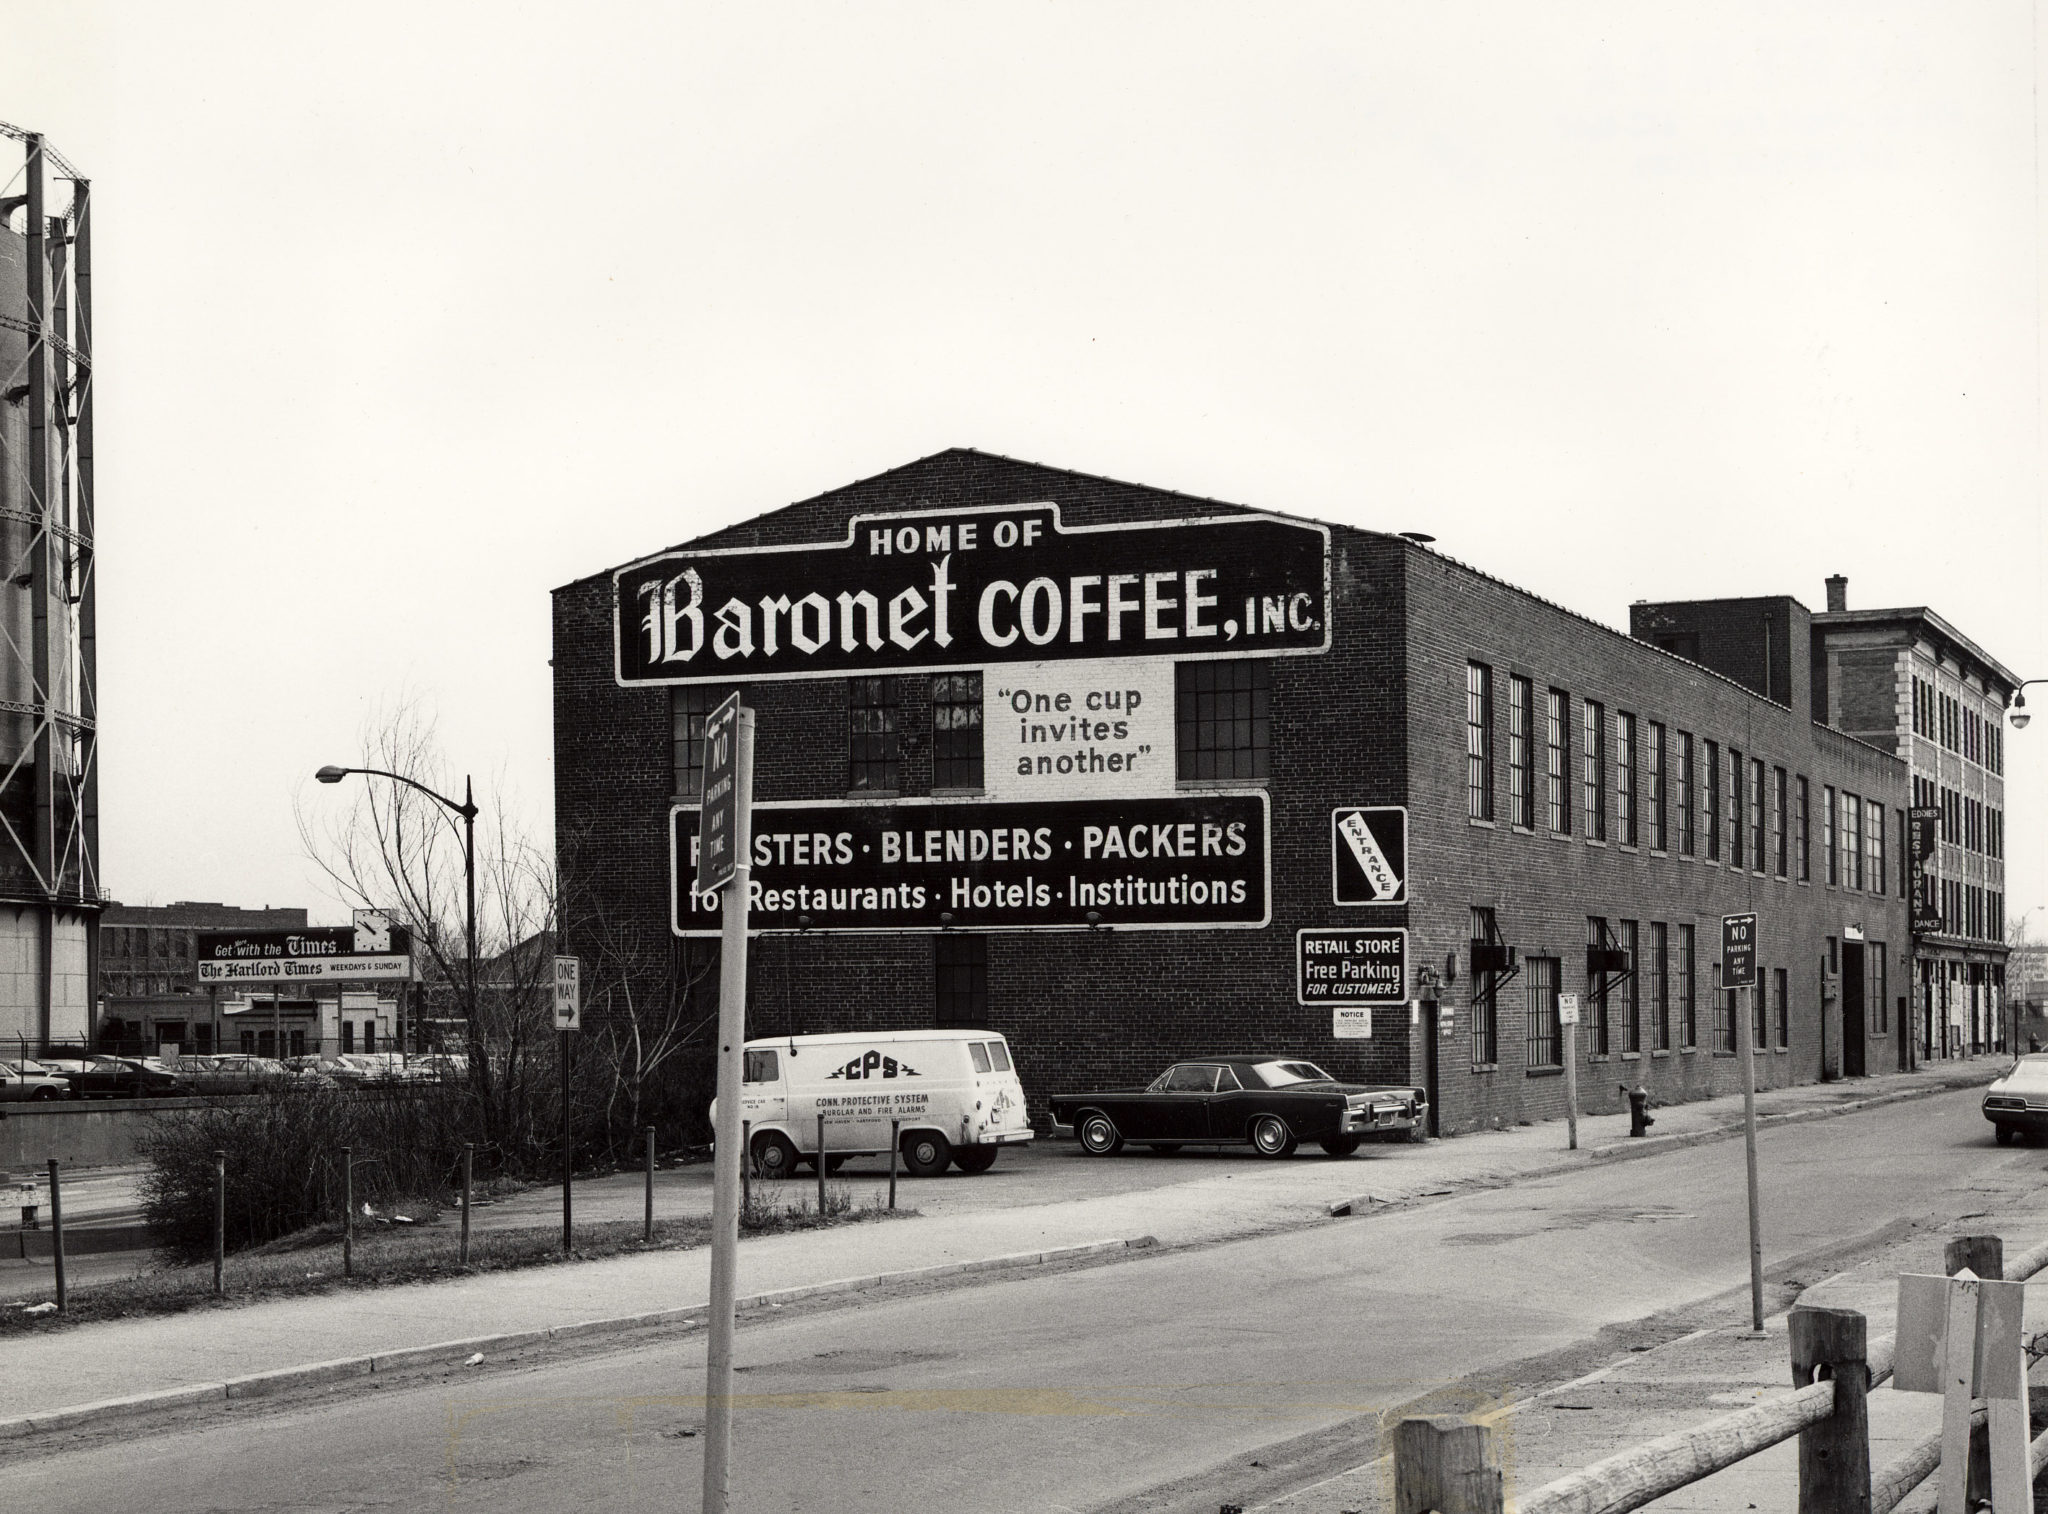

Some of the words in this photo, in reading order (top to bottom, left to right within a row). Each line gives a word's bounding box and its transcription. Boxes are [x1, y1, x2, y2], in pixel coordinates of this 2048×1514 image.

[870, 523, 977, 555] HOME
[993, 520, 1042, 548] OF
[637, 553, 957, 664] Baronet
[978, 569, 1238, 647] COFFEE,
[1245, 592, 1321, 634] INC.
[1086, 689, 1142, 716] cup
[1021, 715, 1129, 743] invites
[713, 732, 727, 772] NO
[706, 773, 731, 806] PARKING
[712, 809, 724, 832] ANY
[1912, 809, 1938, 818] EDDIES
[710, 834, 725, 858] TIME
[882, 827, 1052, 864] BLENDERS
[1084, 822, 1247, 859] PACKERS
[1347, 819, 1390, 892] ENTRANCE
[1911, 822, 1922, 917] RESTAURANT
[690, 879, 725, 912] fo
[747, 880, 926, 911] Restaurants
[951, 876, 1051, 909] Hotels
[1070, 874, 1247, 906] Institutions
[1732, 926, 1747, 940] NO
[1914, 920, 1940, 928] DANCE
[215, 944, 232, 956] Get
[237, 943, 260, 956] with
[264, 943, 282, 956] the
[1305, 940, 1350, 954] RETAIL
[1355, 939, 1400, 953] STORE
[1727, 944, 1751, 954] PARKING
[200, 963, 222, 979] The
[225, 961, 280, 978] Hartford
[283, 961, 322, 976] Times
[330, 963, 366, 972] WEEKDAYS
[374, 962, 402, 970] SUNDAY
[1733, 957, 1745, 965] ANY
[558, 963, 575, 980] ONE
[1306, 960, 1337, 979] Free
[1342, 960, 1400, 983] Parking
[1732, 967, 1746, 976] TIME
[558, 984, 575, 999] WAY
[1306, 984, 1328, 995] FOR
[1332, 983, 1400, 995] CUSTOMERS
[846, 1050, 898, 1080] CPS
[816, 1098, 840, 1107] CONN.
[842, 1096, 891, 1106] PROTECTIVE
[894, 1094, 929, 1104] SYSTEM
[878, 1107, 893, 1115] FIRE
[899, 1105, 926, 1114] ALARMS
